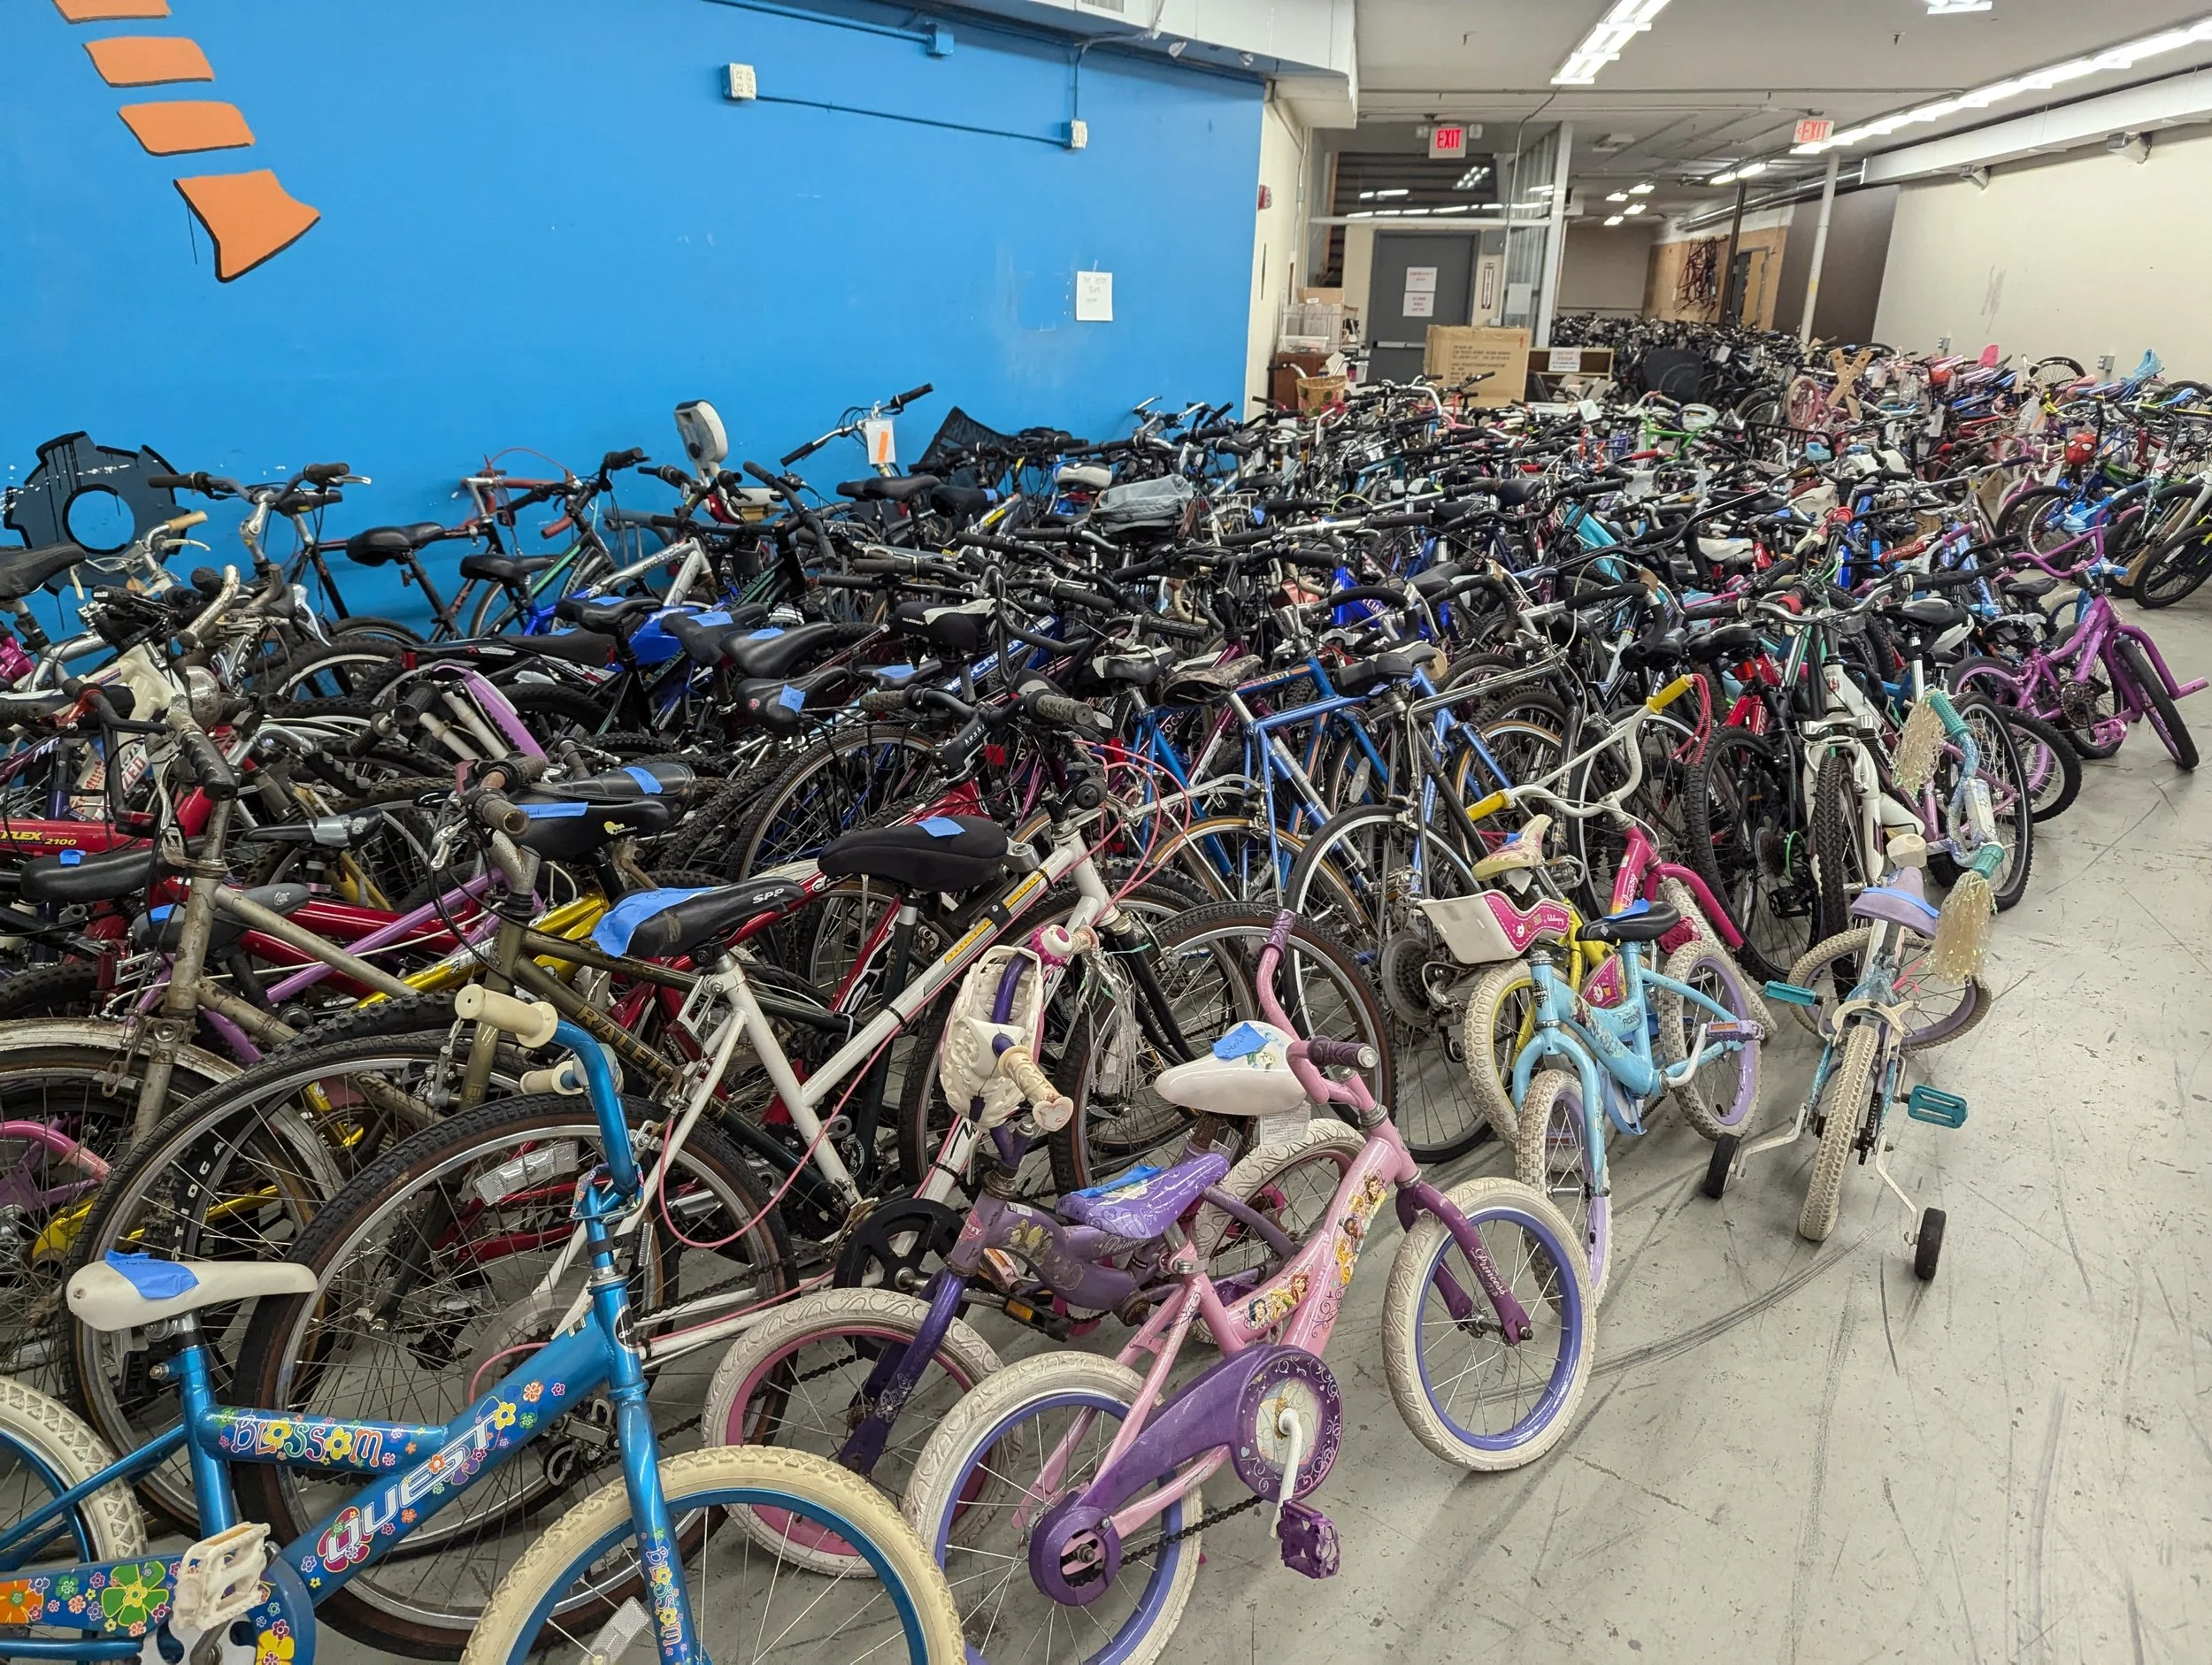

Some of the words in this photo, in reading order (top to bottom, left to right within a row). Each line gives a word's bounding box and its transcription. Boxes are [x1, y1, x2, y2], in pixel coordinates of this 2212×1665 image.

[1437, 128, 1462, 149] EXIT
[1800, 120, 1829, 142] EXIT
[0, 830, 43, 841] FLEX
[752, 887, 785, 904] SPP
[326, 1411, 497, 1564] QUEST
